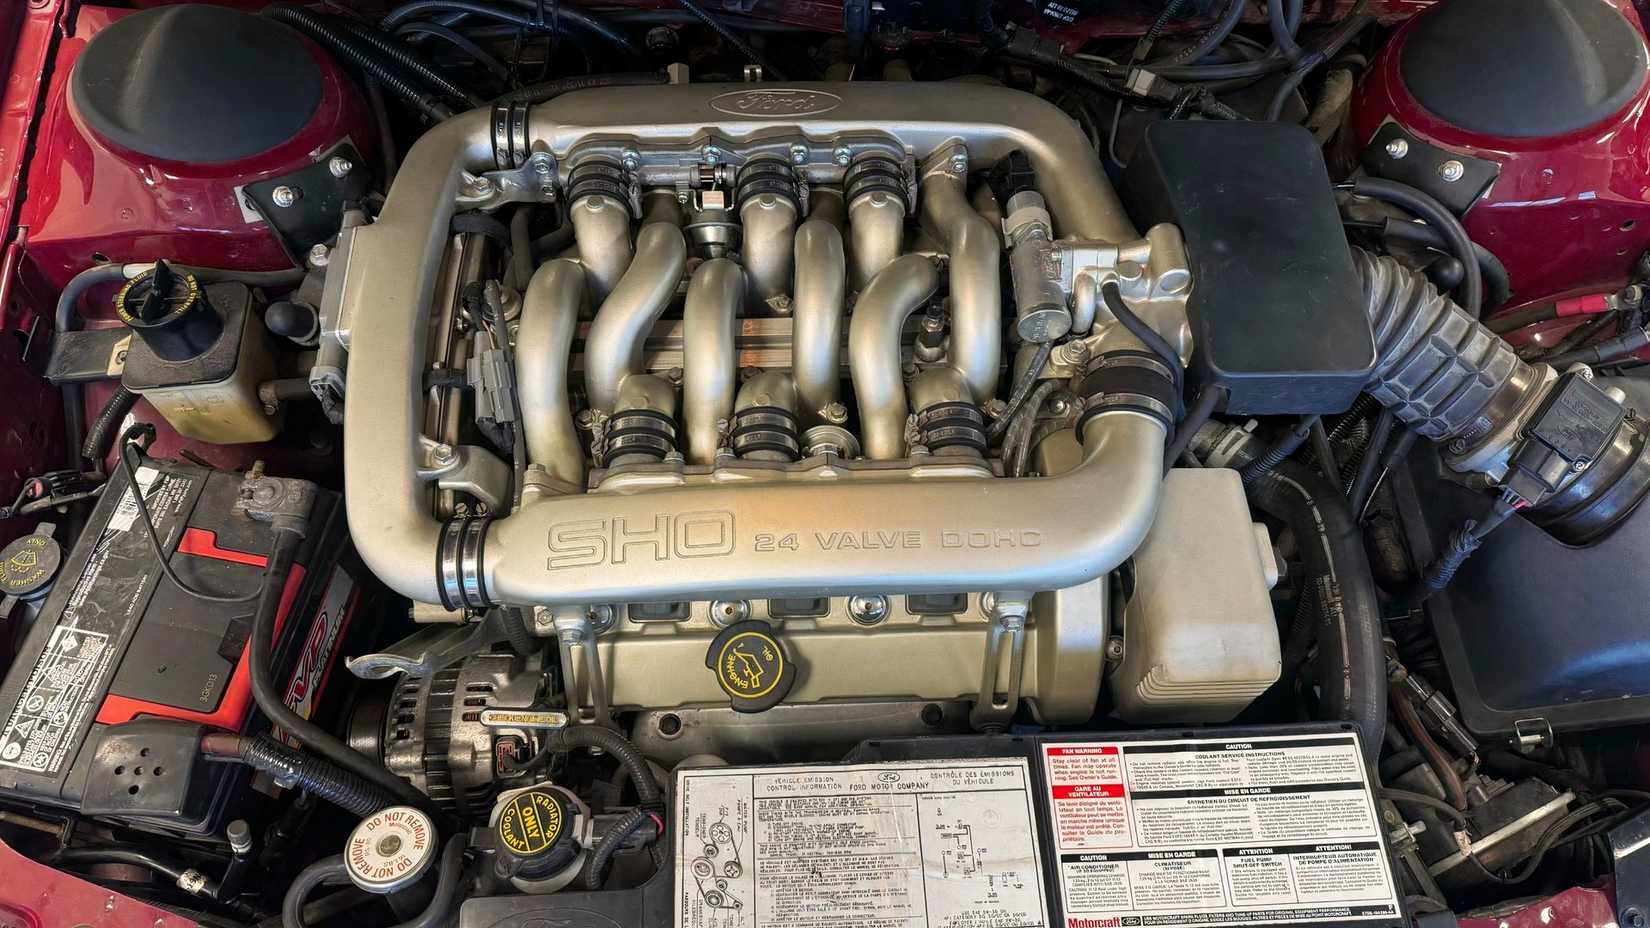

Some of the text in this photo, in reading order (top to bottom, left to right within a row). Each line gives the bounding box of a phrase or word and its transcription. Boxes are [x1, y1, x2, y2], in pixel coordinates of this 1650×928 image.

[547, 509, 736, 571] SHO
[754, 529, 1041, 552] 24 VALVE DOHC
[727, 645, 774, 689] ENGINE OIL
[366, 812, 426, 850] DO NOT REMOVE
[504, 808, 524, 849] COOLANT
[522, 806, 540, 838] ONLY
[536, 796, 558, 838] RADIATOR
[352, 838, 373, 874] REMOVE
[371, 867, 394, 878] NOT
[397, 858, 412, 871] DO
[1068, 916, 1120, 928] Motorcraft
